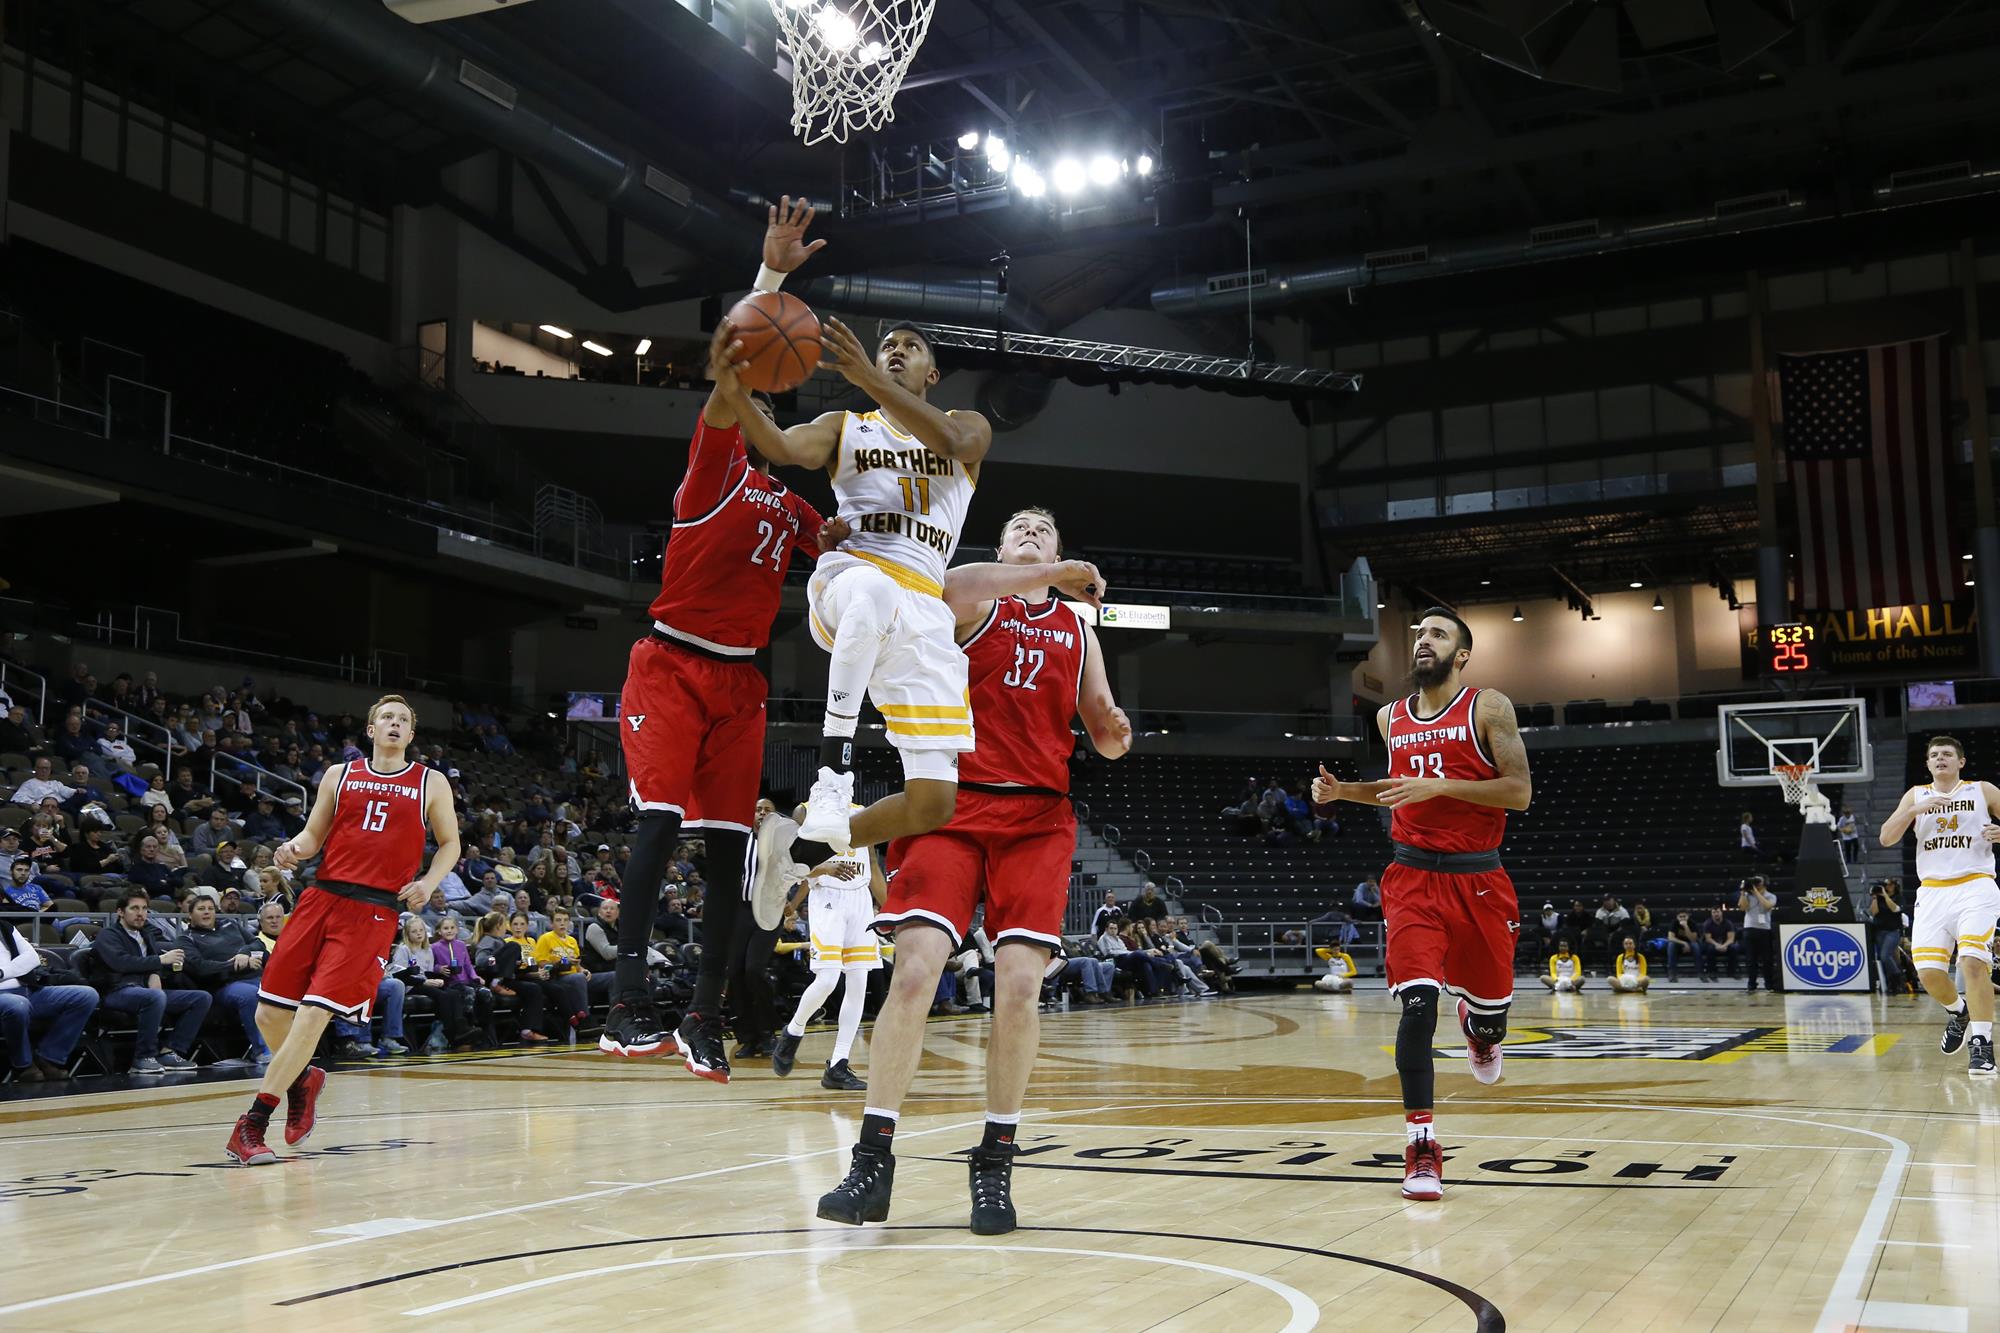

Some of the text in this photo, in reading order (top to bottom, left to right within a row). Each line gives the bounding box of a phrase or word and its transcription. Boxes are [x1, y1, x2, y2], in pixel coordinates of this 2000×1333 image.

[898, 477, 930, 516] 11
[751, 520, 789, 572] 24
[1129, 611, 1166, 620] Elizabeth
[1771, 626, 1814, 643] 15:27
[1003, 643, 1045, 691] 32
[1774, 643, 1808, 670] 25
[1832, 645, 1966, 664] Home of the Norse
[1391, 726, 1466, 751] YOUNGSTOWN
[1403, 740, 1445, 750] STATE
[1410, 752, 1446, 778] 23
[346, 780, 418, 800] YOUNGSTOWN
[362, 800, 389, 832] 15
[1936, 815, 1958, 833] 34
[1793, 936, 1858, 980] Kroger
[1016, 1134, 1739, 1164] LEGUE
